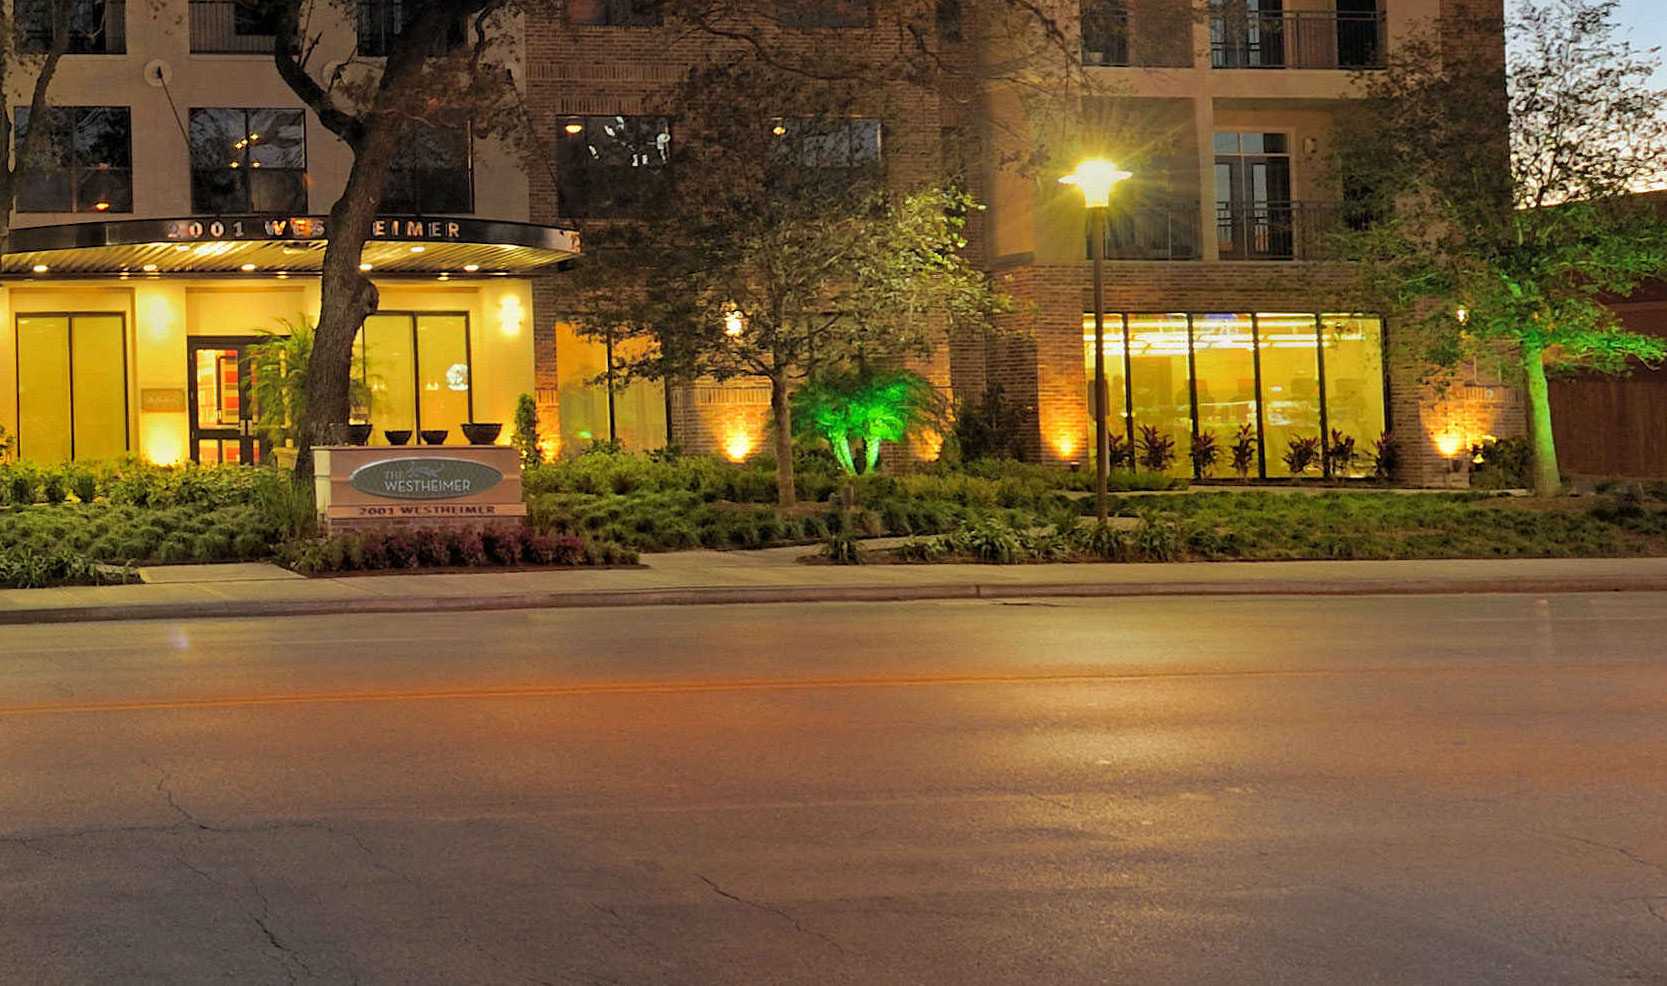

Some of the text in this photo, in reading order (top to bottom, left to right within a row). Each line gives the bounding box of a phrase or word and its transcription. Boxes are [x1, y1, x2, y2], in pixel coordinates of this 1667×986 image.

[167, 219, 461, 239] 2001 WESEIMER
[384, 470, 405, 480] THE
[384, 479, 471, 492] WESTHEIMER
[359, 505, 495, 515] 2001 WESTHEIMER
